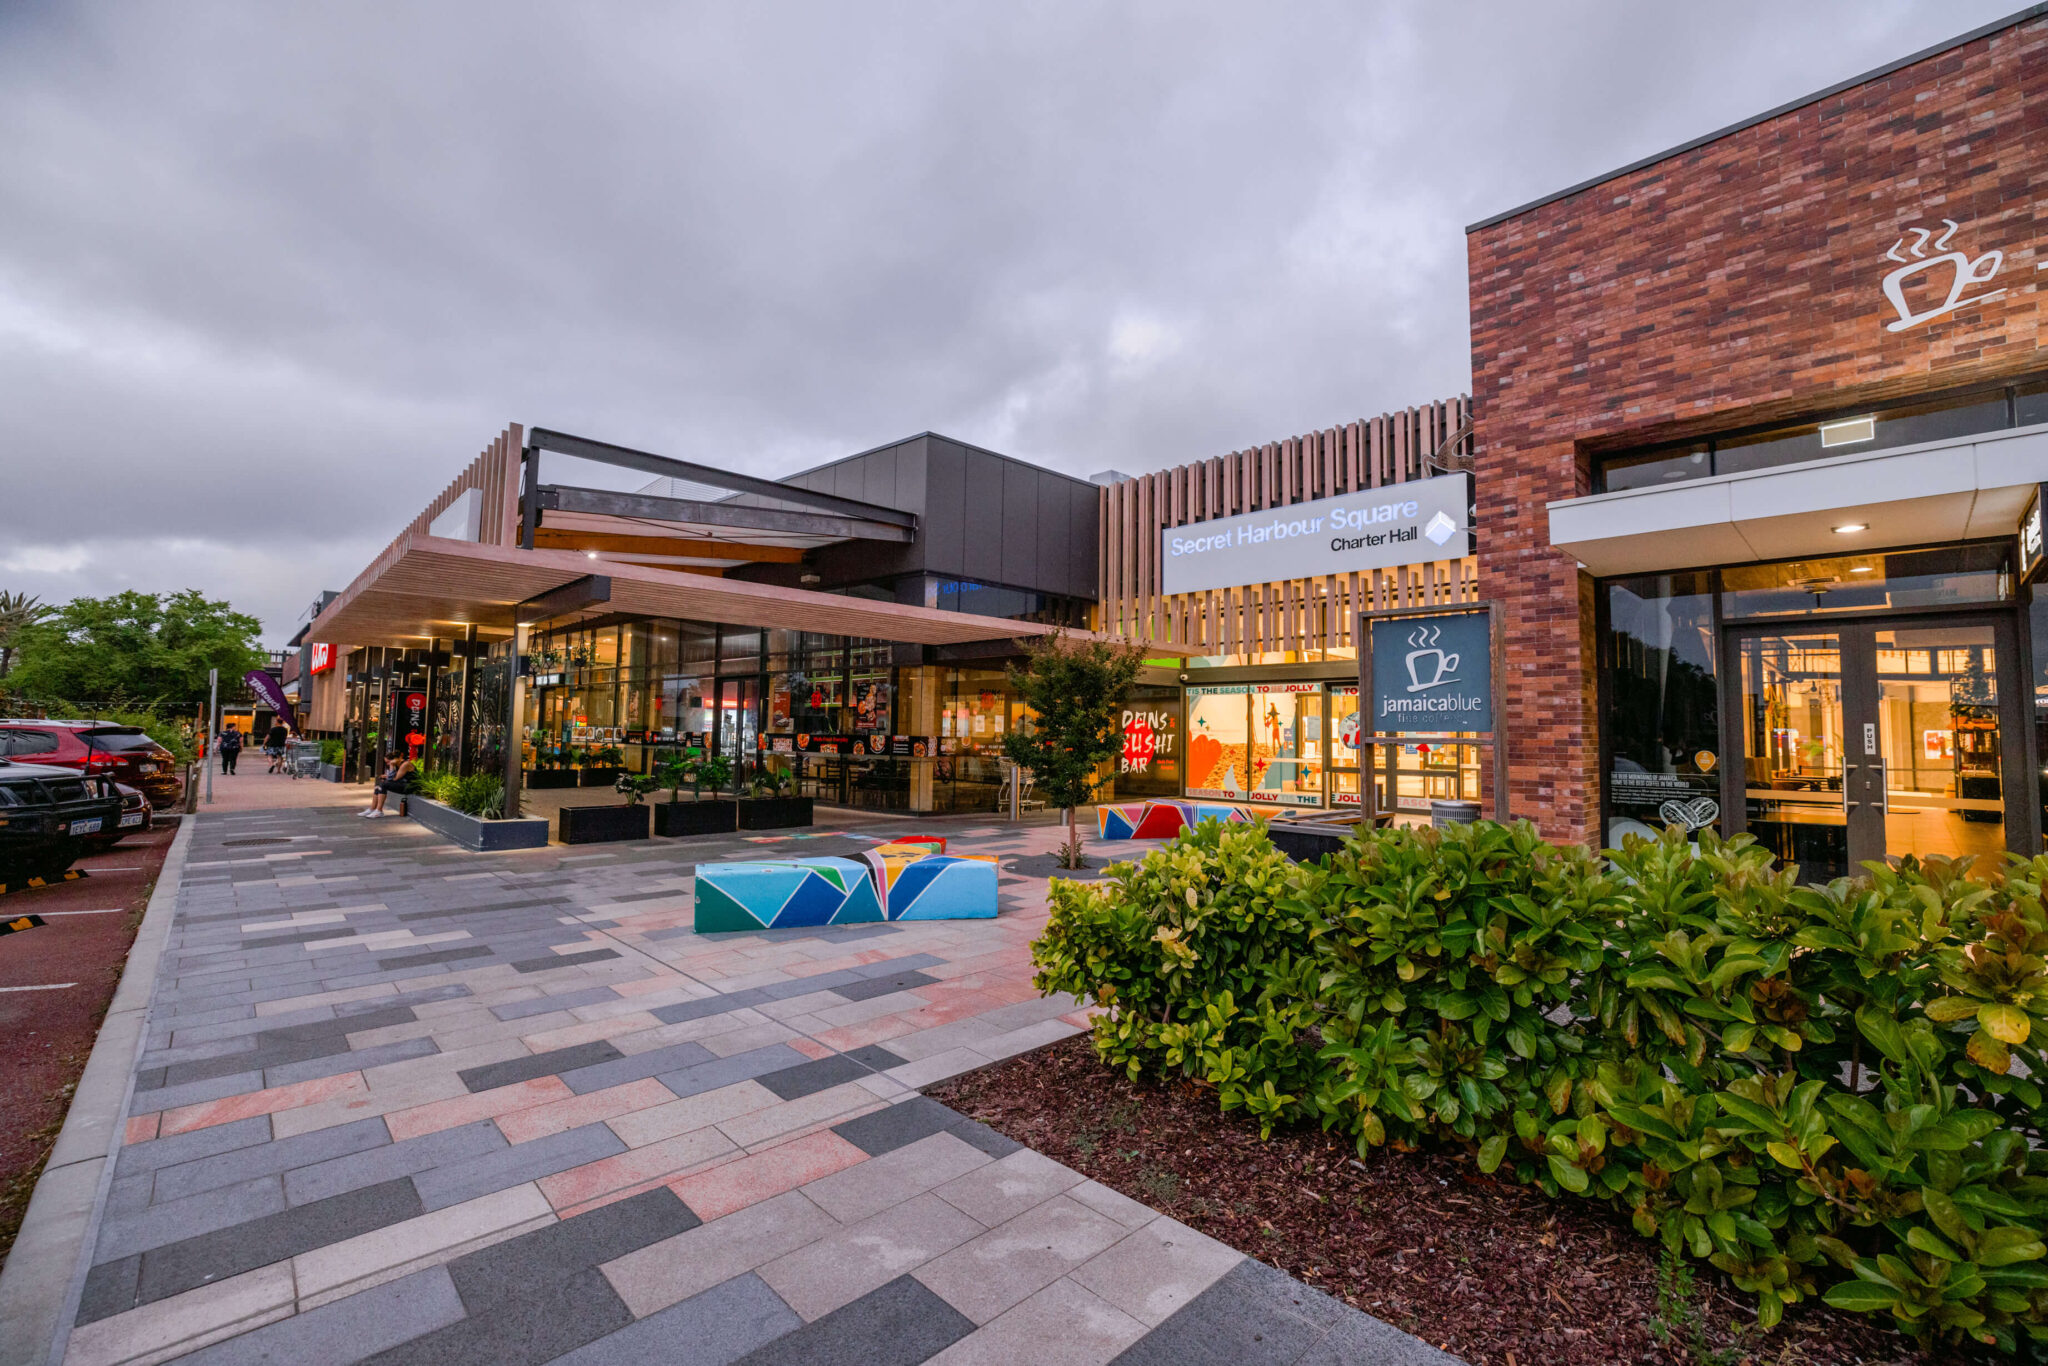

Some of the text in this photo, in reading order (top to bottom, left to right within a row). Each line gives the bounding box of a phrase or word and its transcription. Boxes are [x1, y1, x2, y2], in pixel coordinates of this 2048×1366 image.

[1170, 500, 1418, 556] Secret Harbour Square
[1330, 526, 1418, 551] Charter Hall
[1257, 685, 1269, 693] TO
[1285, 683, 1314, 692] JOLLY
[1343, 687, 1358, 695] TO
[1380, 693, 1482, 718] jamaicablue
[1120, 733, 1175, 754] SUSHI
[1121, 757, 1148, 774] BAR
[1223, 790, 1236, 798] TO
[1250, 792, 1277, 800] JOLLY
[1297, 795, 1317, 804] THE
[1337, 794, 1361, 803] JOLL
